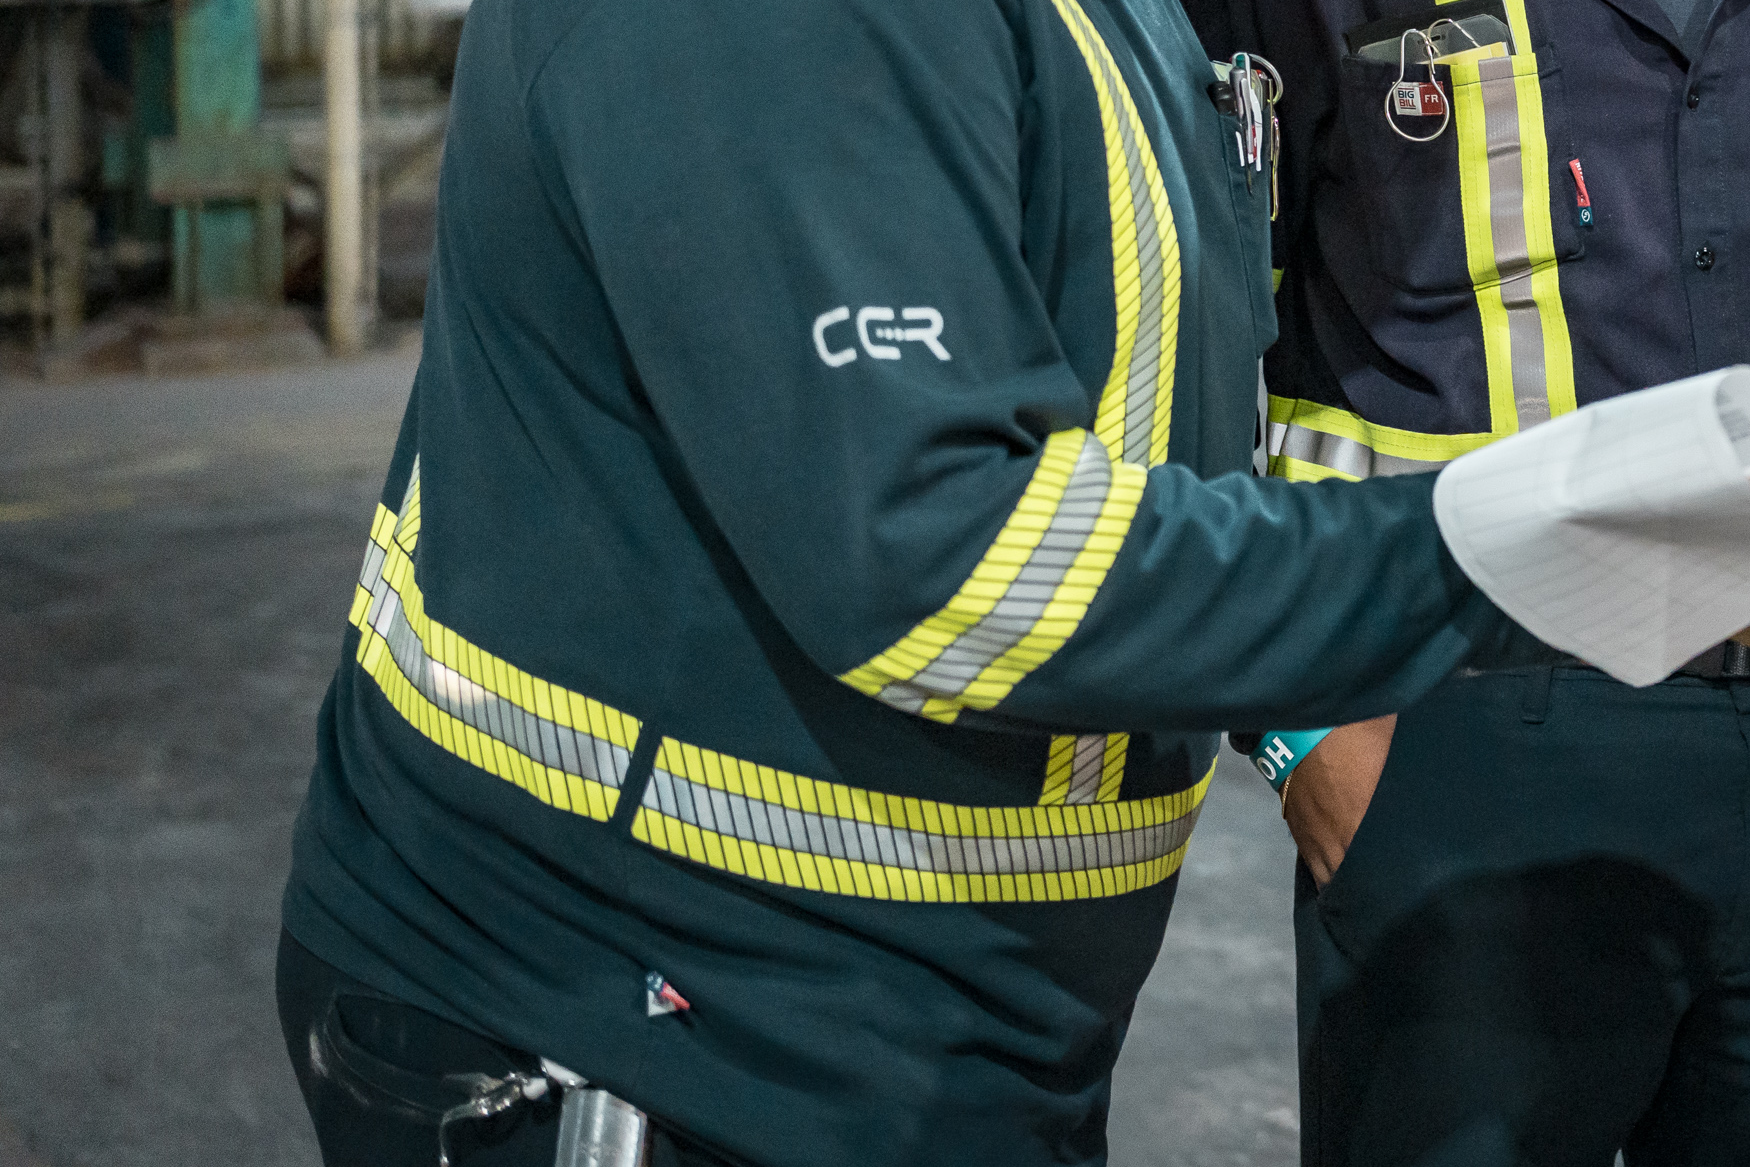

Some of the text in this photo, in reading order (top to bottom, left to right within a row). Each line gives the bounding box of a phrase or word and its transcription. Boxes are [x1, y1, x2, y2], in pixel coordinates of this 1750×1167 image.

[1398, 90, 1414, 99] BIG
[1424, 94, 1439, 103] FR
[1399, 99, 1416, 107] BILL
